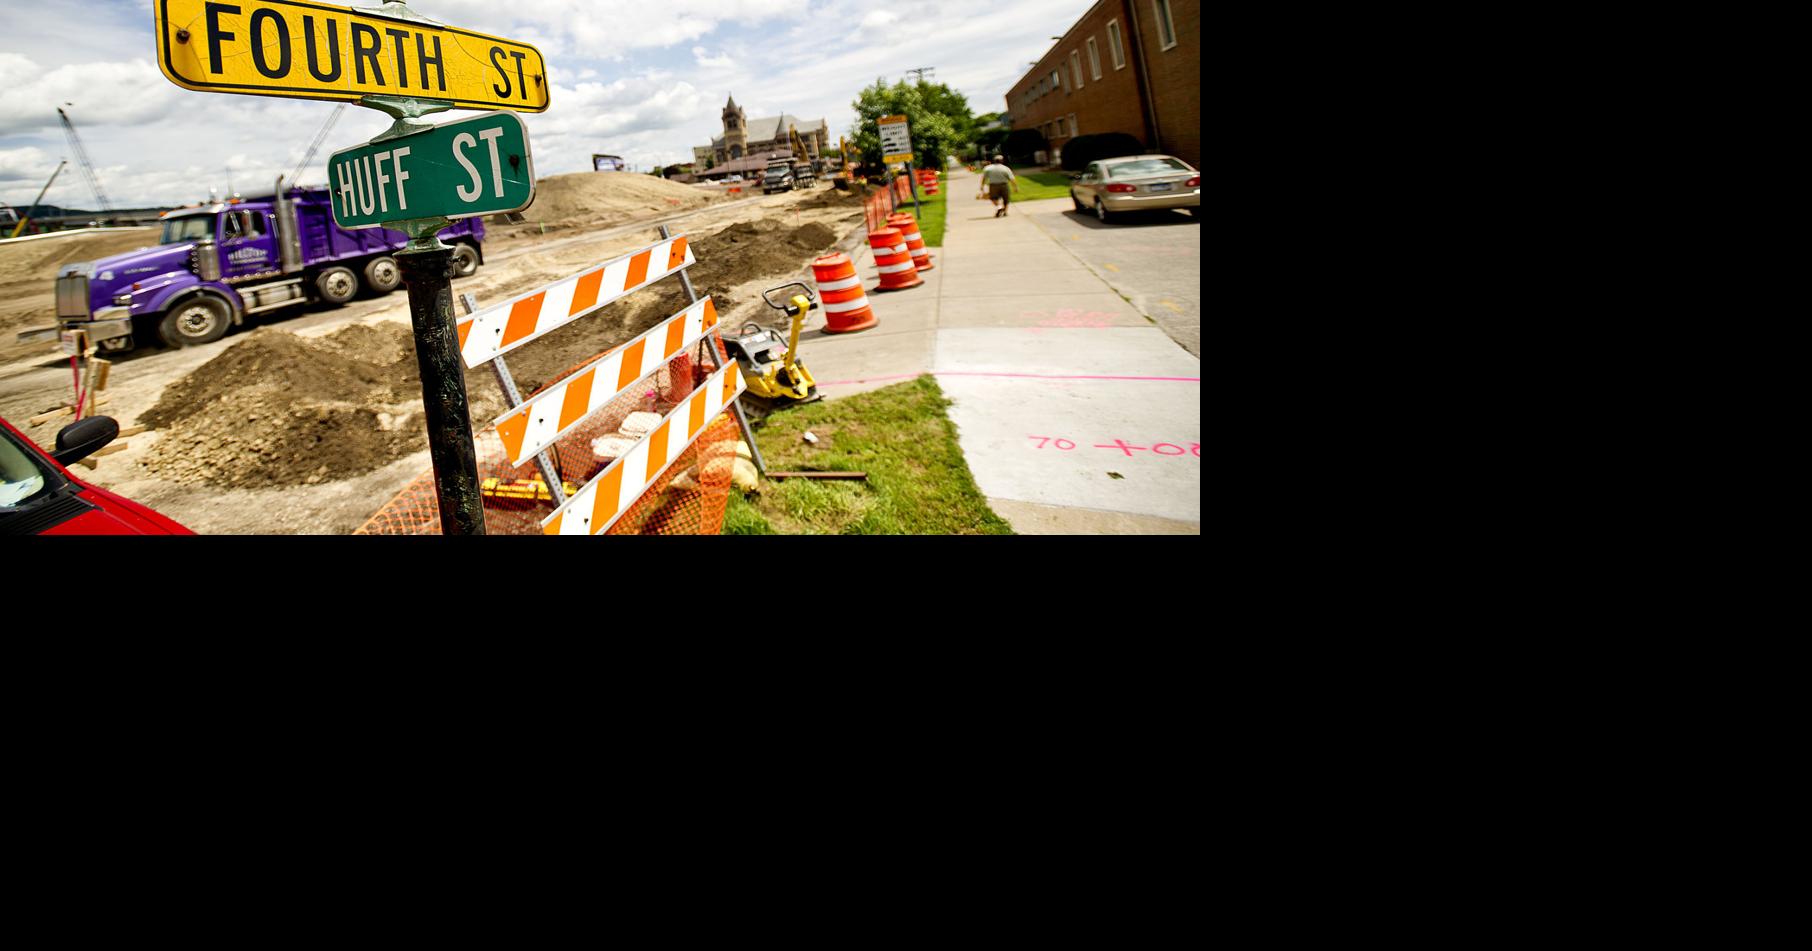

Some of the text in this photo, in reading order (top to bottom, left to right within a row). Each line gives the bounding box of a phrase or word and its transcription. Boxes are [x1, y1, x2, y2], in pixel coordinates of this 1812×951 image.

[205, 2, 529, 100] FOURTH ST
[336, 126, 505, 218] HUFF ST
[1027, 435, 1076, 451] 70
